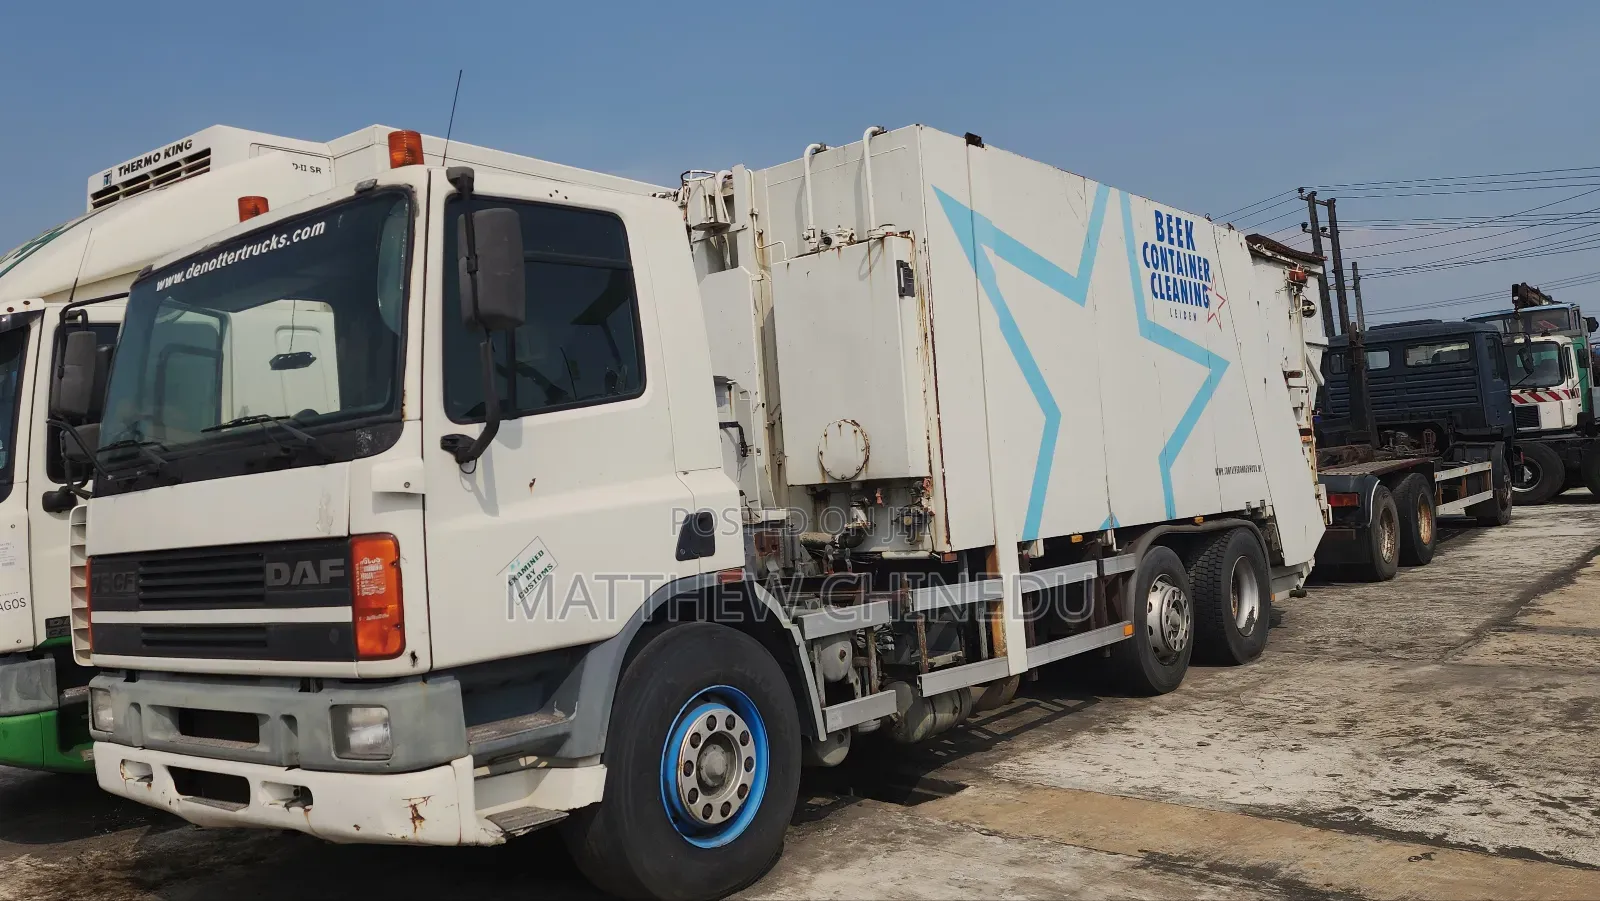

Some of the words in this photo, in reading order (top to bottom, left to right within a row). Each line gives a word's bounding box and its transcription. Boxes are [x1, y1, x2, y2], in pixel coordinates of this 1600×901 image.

[118, 152, 161, 177] THERMO
[163, 139, 193, 160] KING
[1154, 209, 1197, 252] BEEK
[156, 220, 326, 292] www.denottertrucks.com
[1142, 241, 1212, 283] CONTAINER
[1150, 271, 1210, 309] CLEANING
[265, 557, 345, 587] DAF
[507, 549, 545, 587] EXAMINED
[518, 563, 554, 600] CUSTOMS
[525, 567, 536, 581] BY
